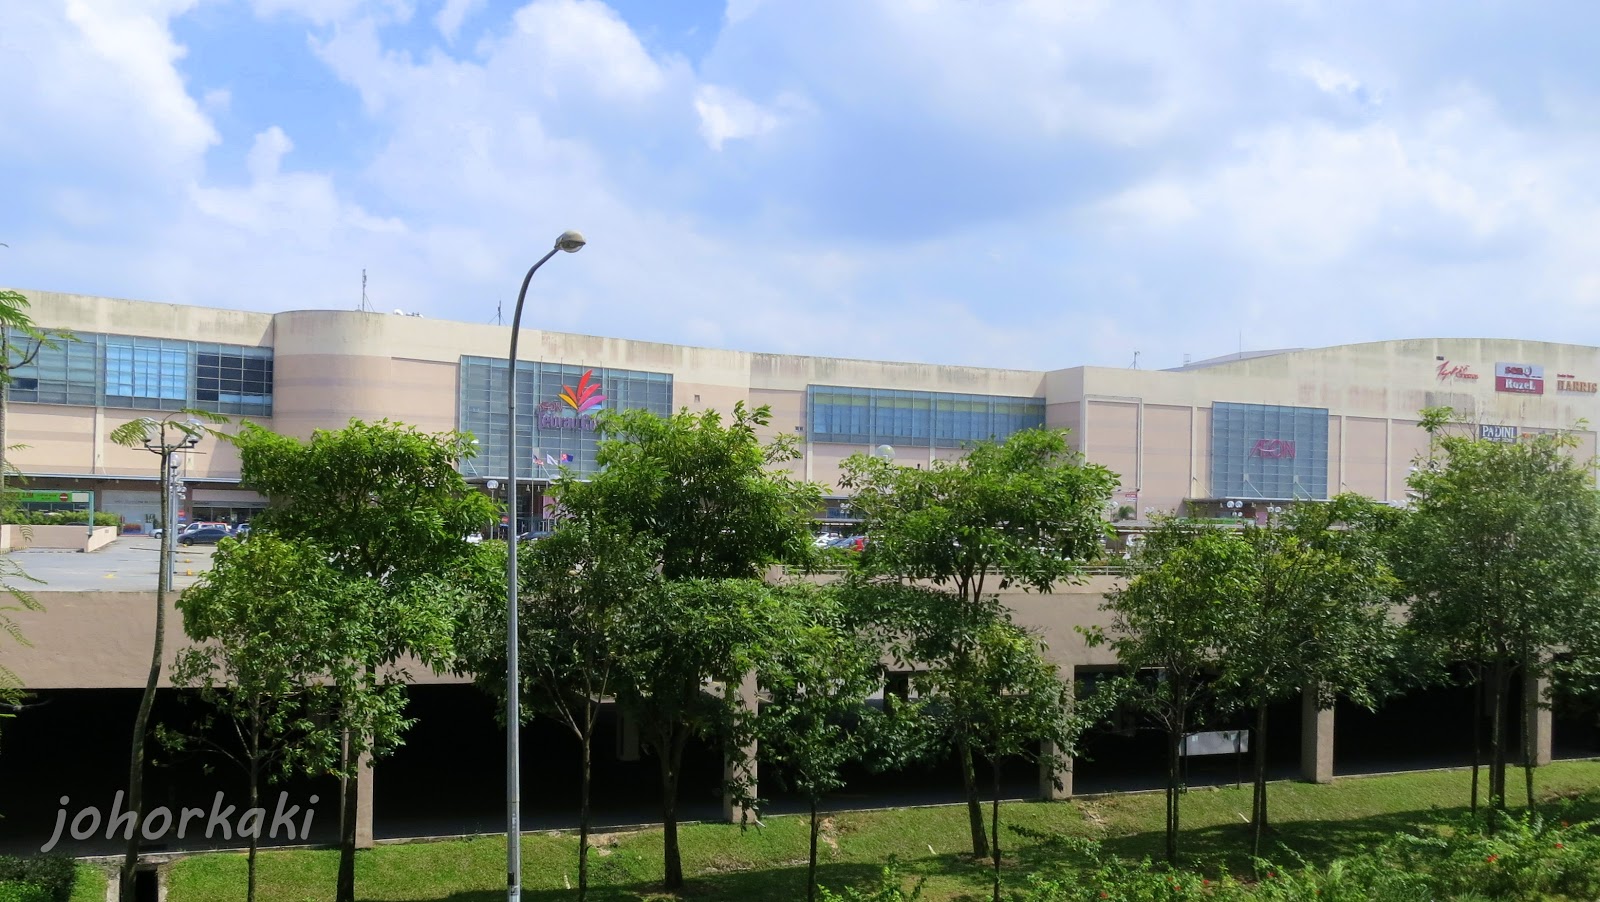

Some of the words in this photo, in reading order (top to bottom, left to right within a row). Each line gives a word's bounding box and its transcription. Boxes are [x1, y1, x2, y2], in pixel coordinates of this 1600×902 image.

[1557, 380, 1598, 394] HARRIS
[1482, 425, 1515, 439] PADINI
[1249, 439, 1296, 459] AEON
